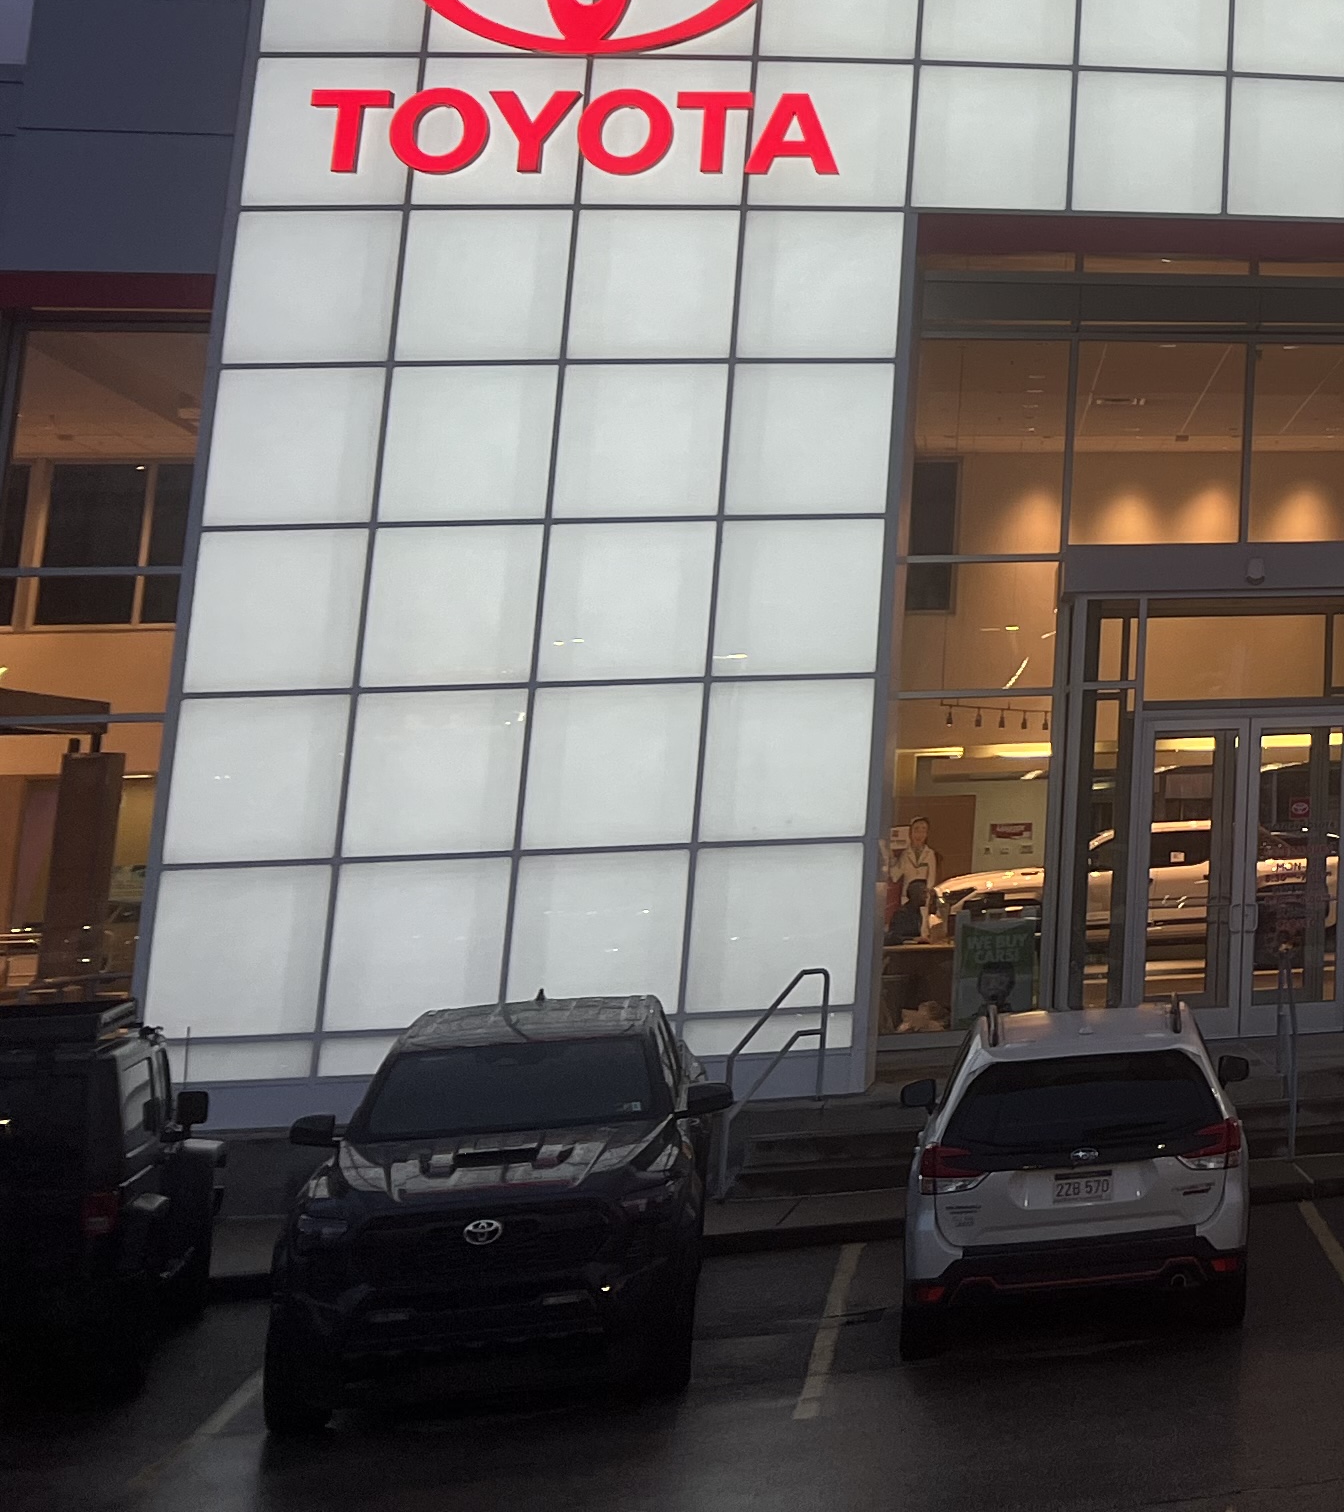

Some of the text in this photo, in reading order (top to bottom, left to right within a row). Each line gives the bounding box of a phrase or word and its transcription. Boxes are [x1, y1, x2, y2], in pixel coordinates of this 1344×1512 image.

[310, 87, 840, 176] TOYOTA
[967, 933, 1028, 949] WE BUY
[1085, 1179, 1109, 1194] 570
